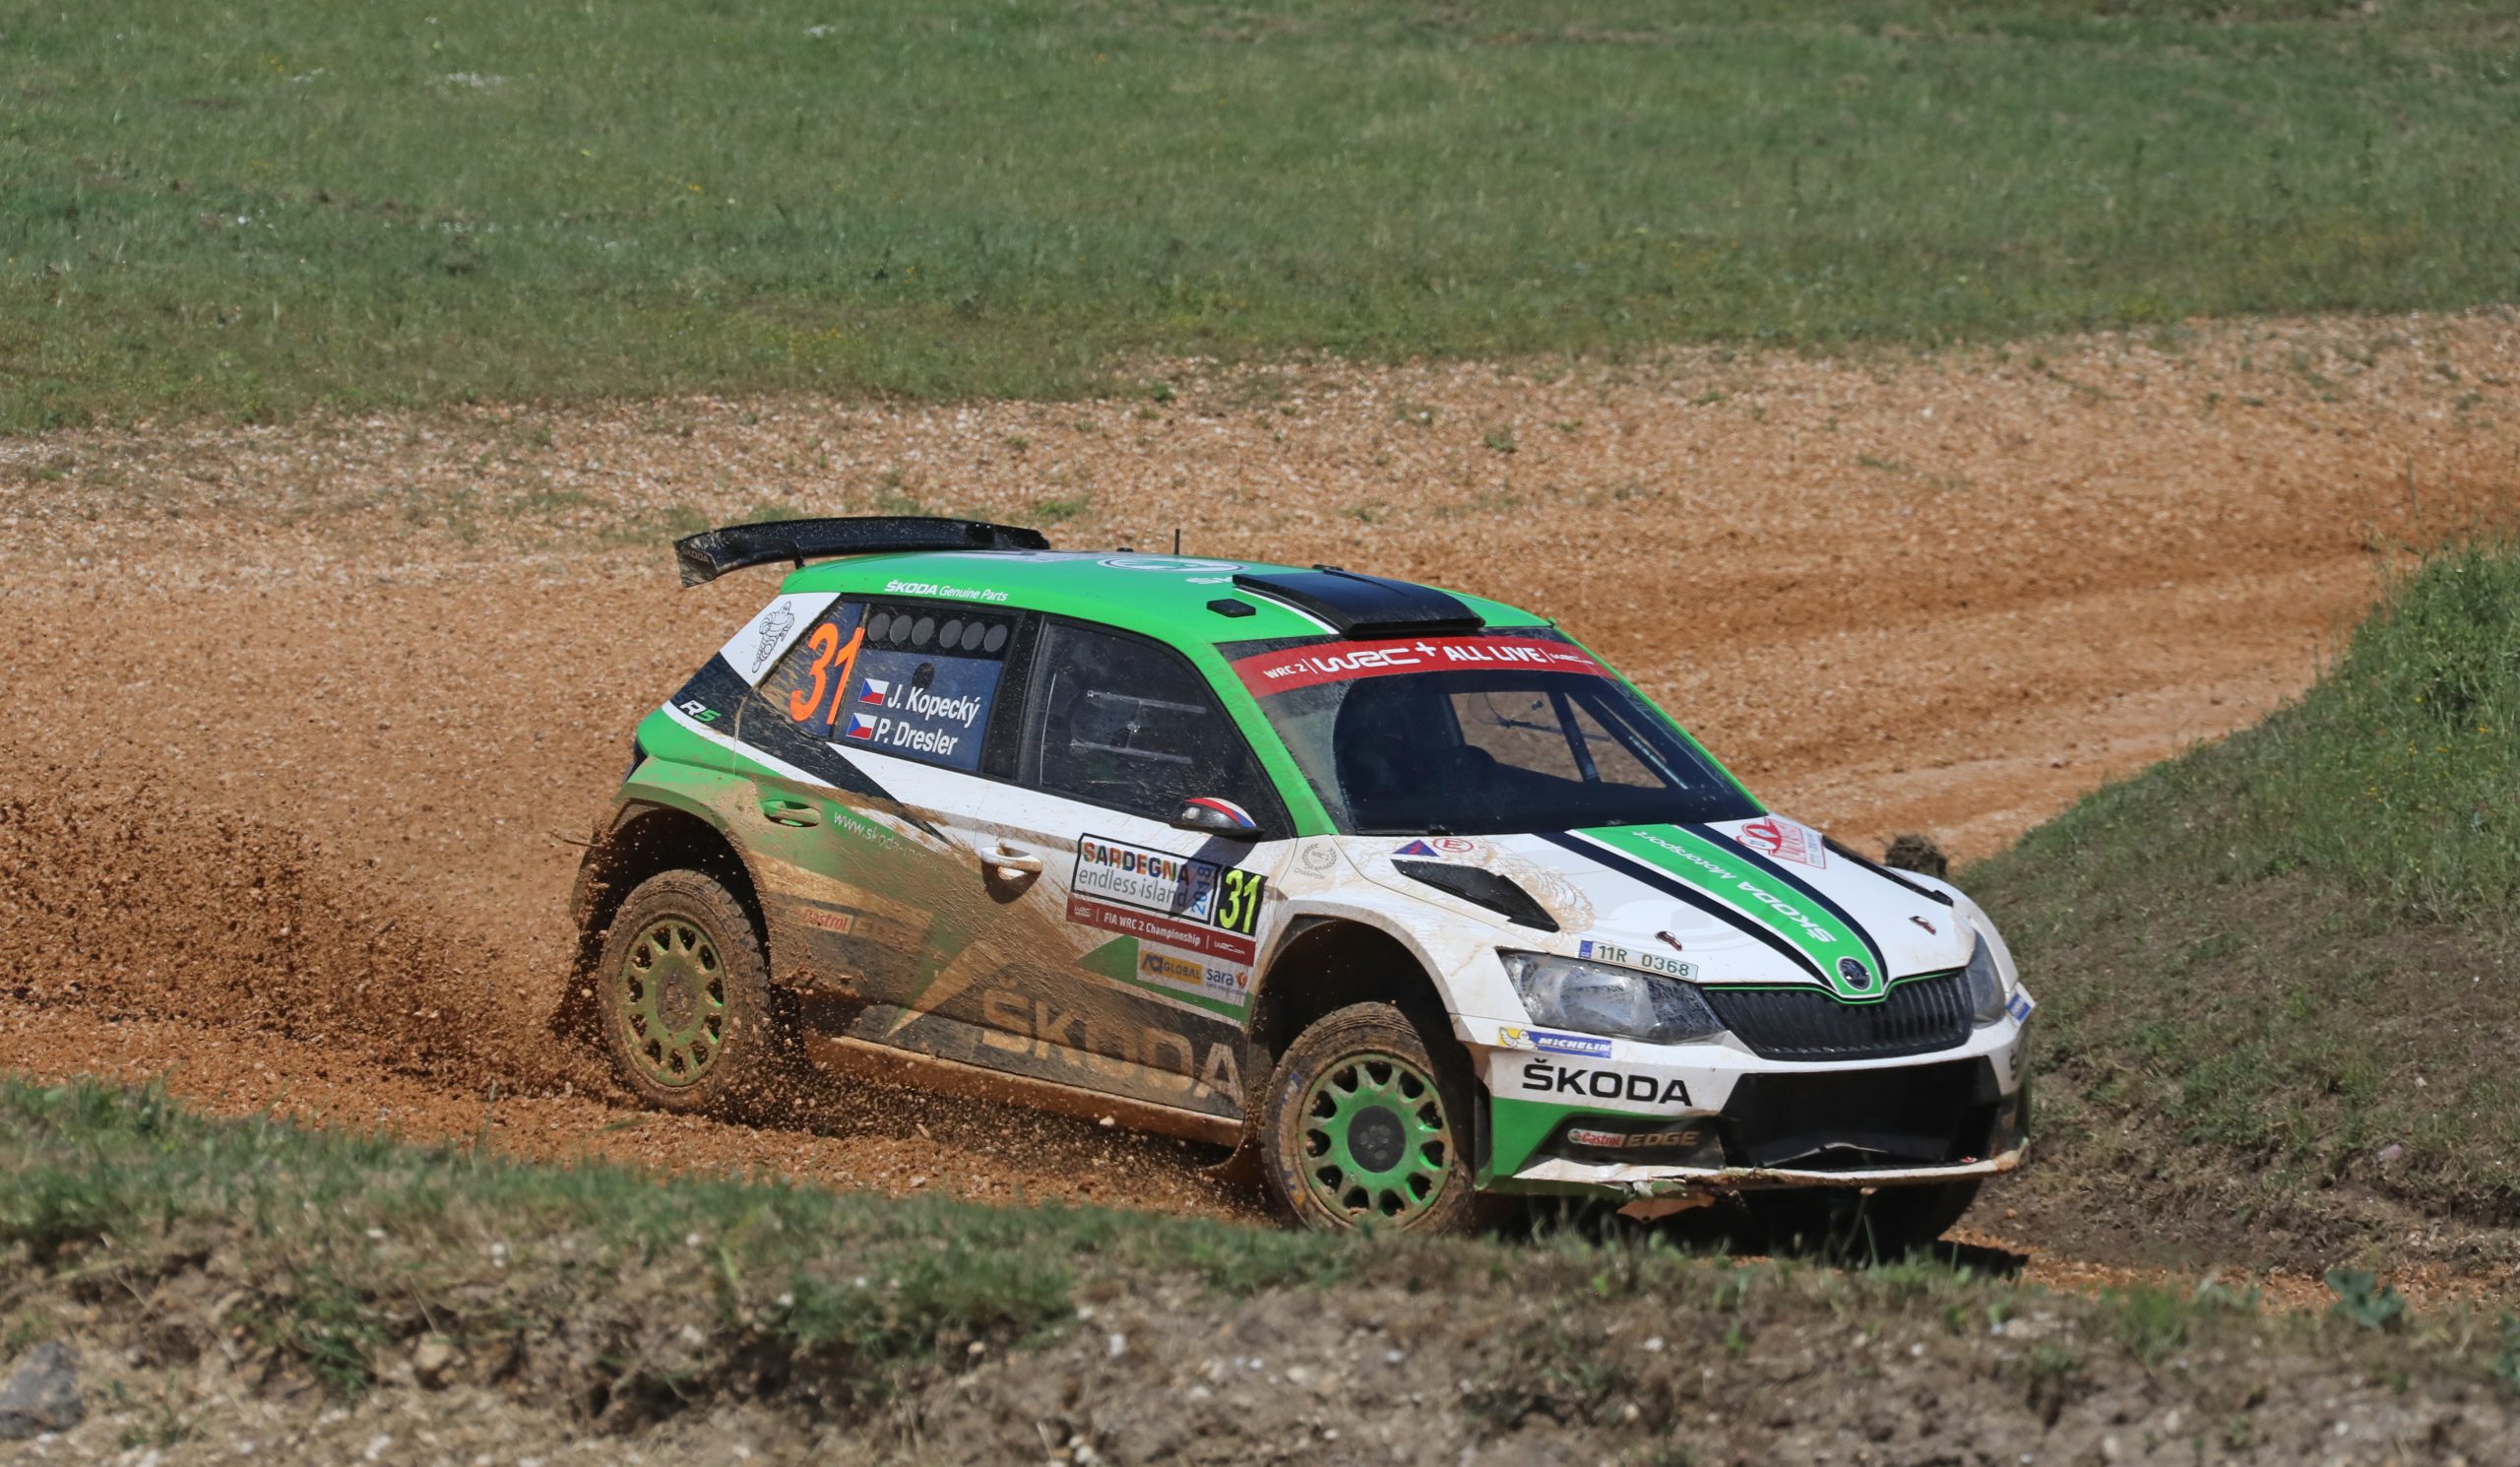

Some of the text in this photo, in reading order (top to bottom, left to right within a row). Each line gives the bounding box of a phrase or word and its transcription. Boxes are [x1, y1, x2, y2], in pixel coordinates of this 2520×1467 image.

[884, 580, 1009, 602] ŠKODA Genuine Parts
[790, 622, 865, 726] 31
[1263, 666, 1296, 679] WRC
[1294, 663, 1308, 672] 2
[1442, 645, 1493, 662] ALL
[1486, 645, 1547, 663] LIVE
[680, 700, 723, 723] R5
[887, 684, 980, 729] J. Kopecký
[874, 718, 959, 756] P. Dresler
[1083, 842, 1190, 886] SARDEGNA
[1632, 831, 1737, 879] Motorsport
[1079, 867, 1189, 906] endless island
[1191, 866, 1212, 916] 2018
[1219, 869, 1262, 934] 31
[1103, 913, 1117, 925] FIA
[1119, 916, 1137, 929] WRC
[1138, 921, 1144, 931] 2
[1146, 923, 1201, 947] Championship
[1736, 881, 1838, 943] ŠKODA
[1163, 961, 1200, 981] GLOBAL
[1206, 968, 1234, 986] sara
[1599, 945, 1690, 977] 11R 0368
[981, 977, 1244, 1107] ŠKODA
[1538, 1037, 1611, 1052] MICHELIN
[1522, 1057, 1693, 1107] ŠKODA
[1580, 1131, 1702, 1148] Castrol EDGE
